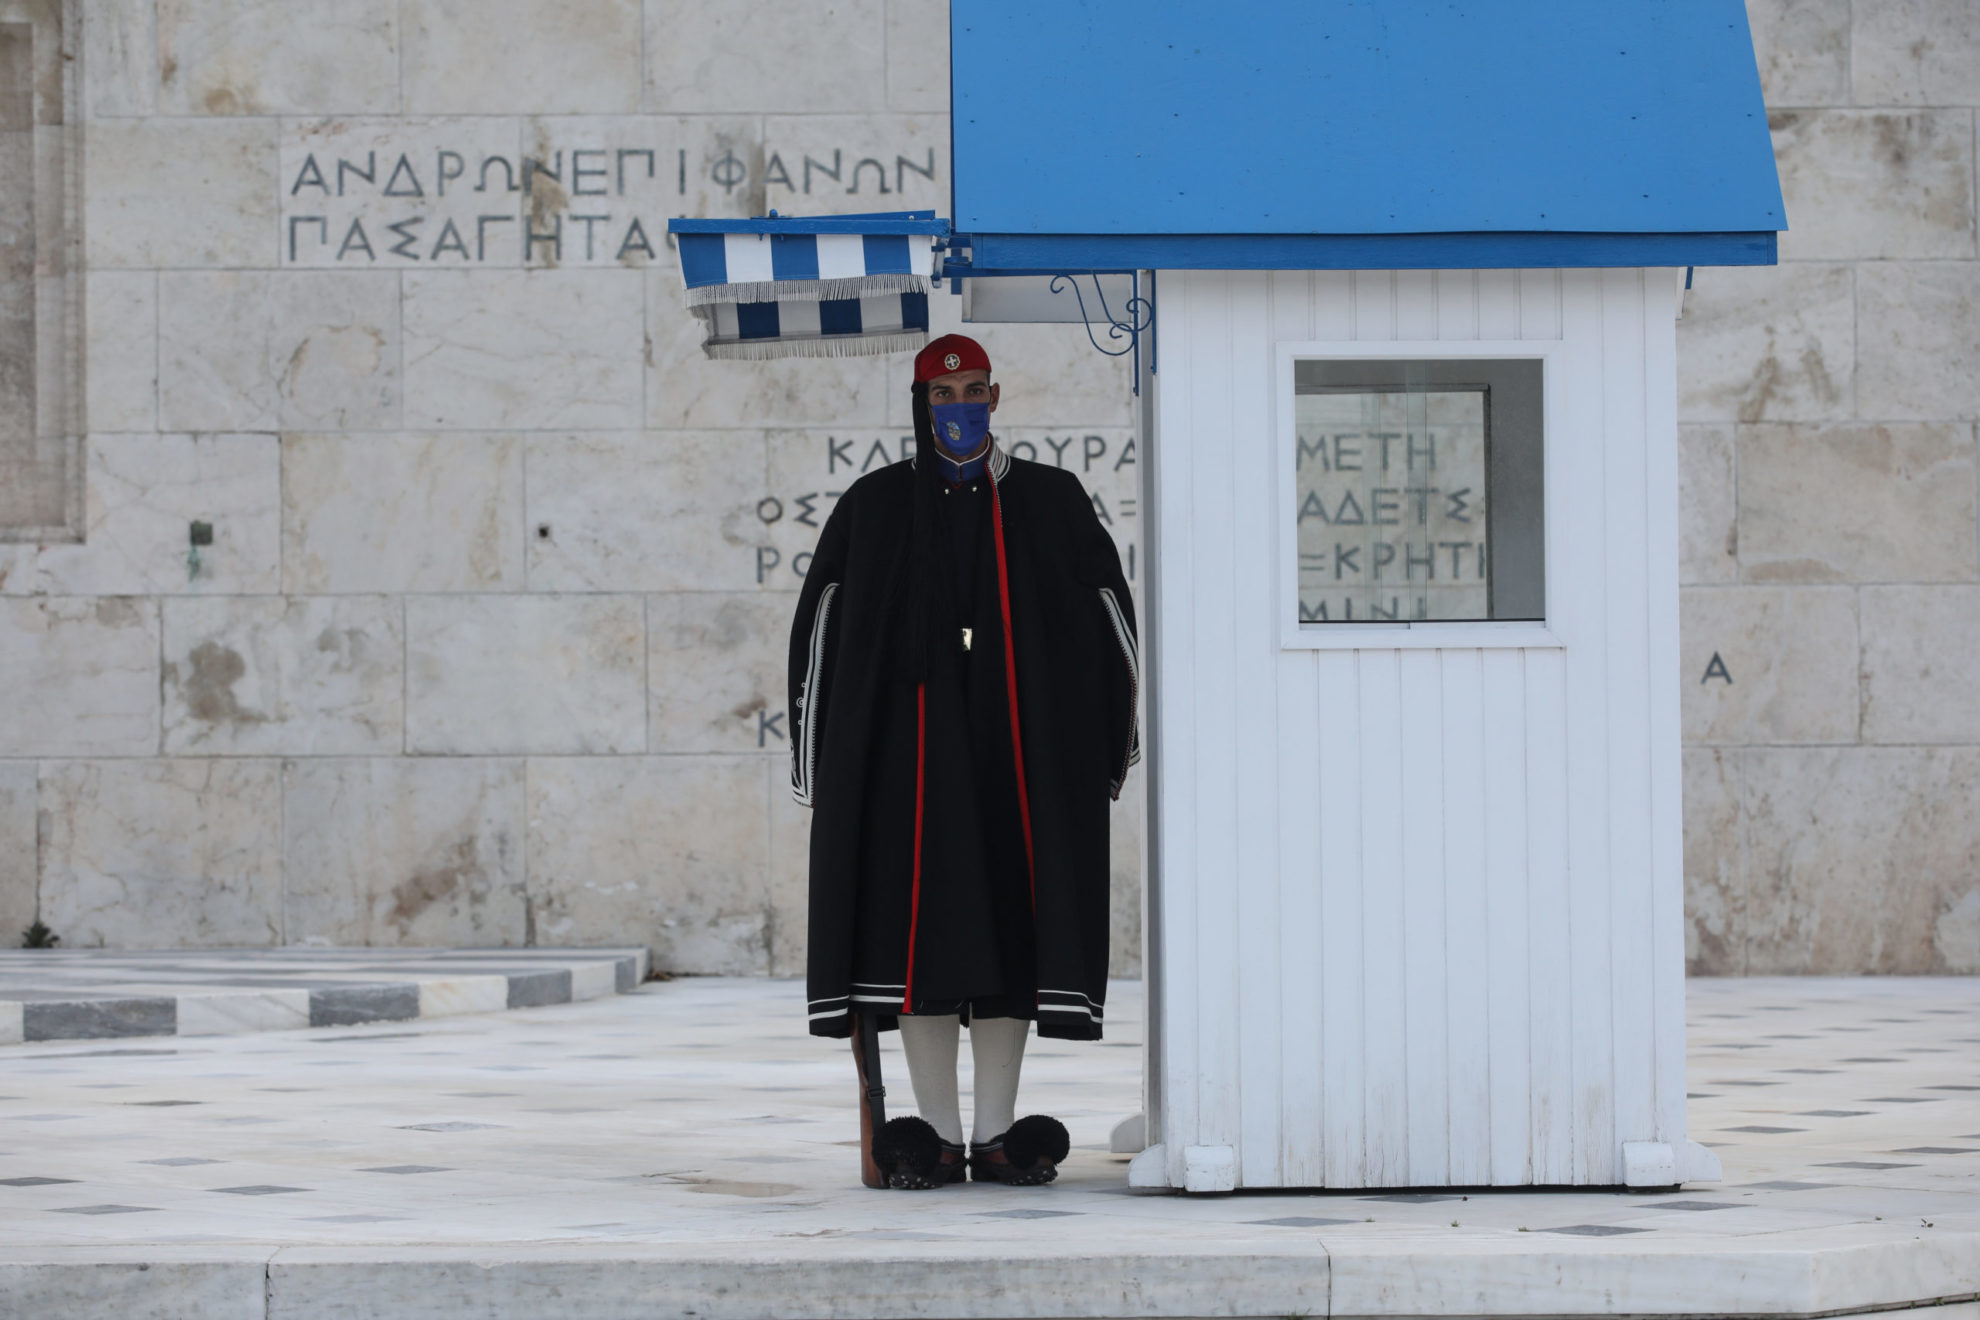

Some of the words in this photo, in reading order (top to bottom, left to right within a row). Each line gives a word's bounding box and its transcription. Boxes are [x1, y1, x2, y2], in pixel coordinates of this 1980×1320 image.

[1296, 432, 1437, 472] ΜΕΤΗ
[1297, 487, 1472, 526] ΑΔΕΤΣ
[1700, 650, 1733, 685] Α
[758, 710, 785, 748] Κ
